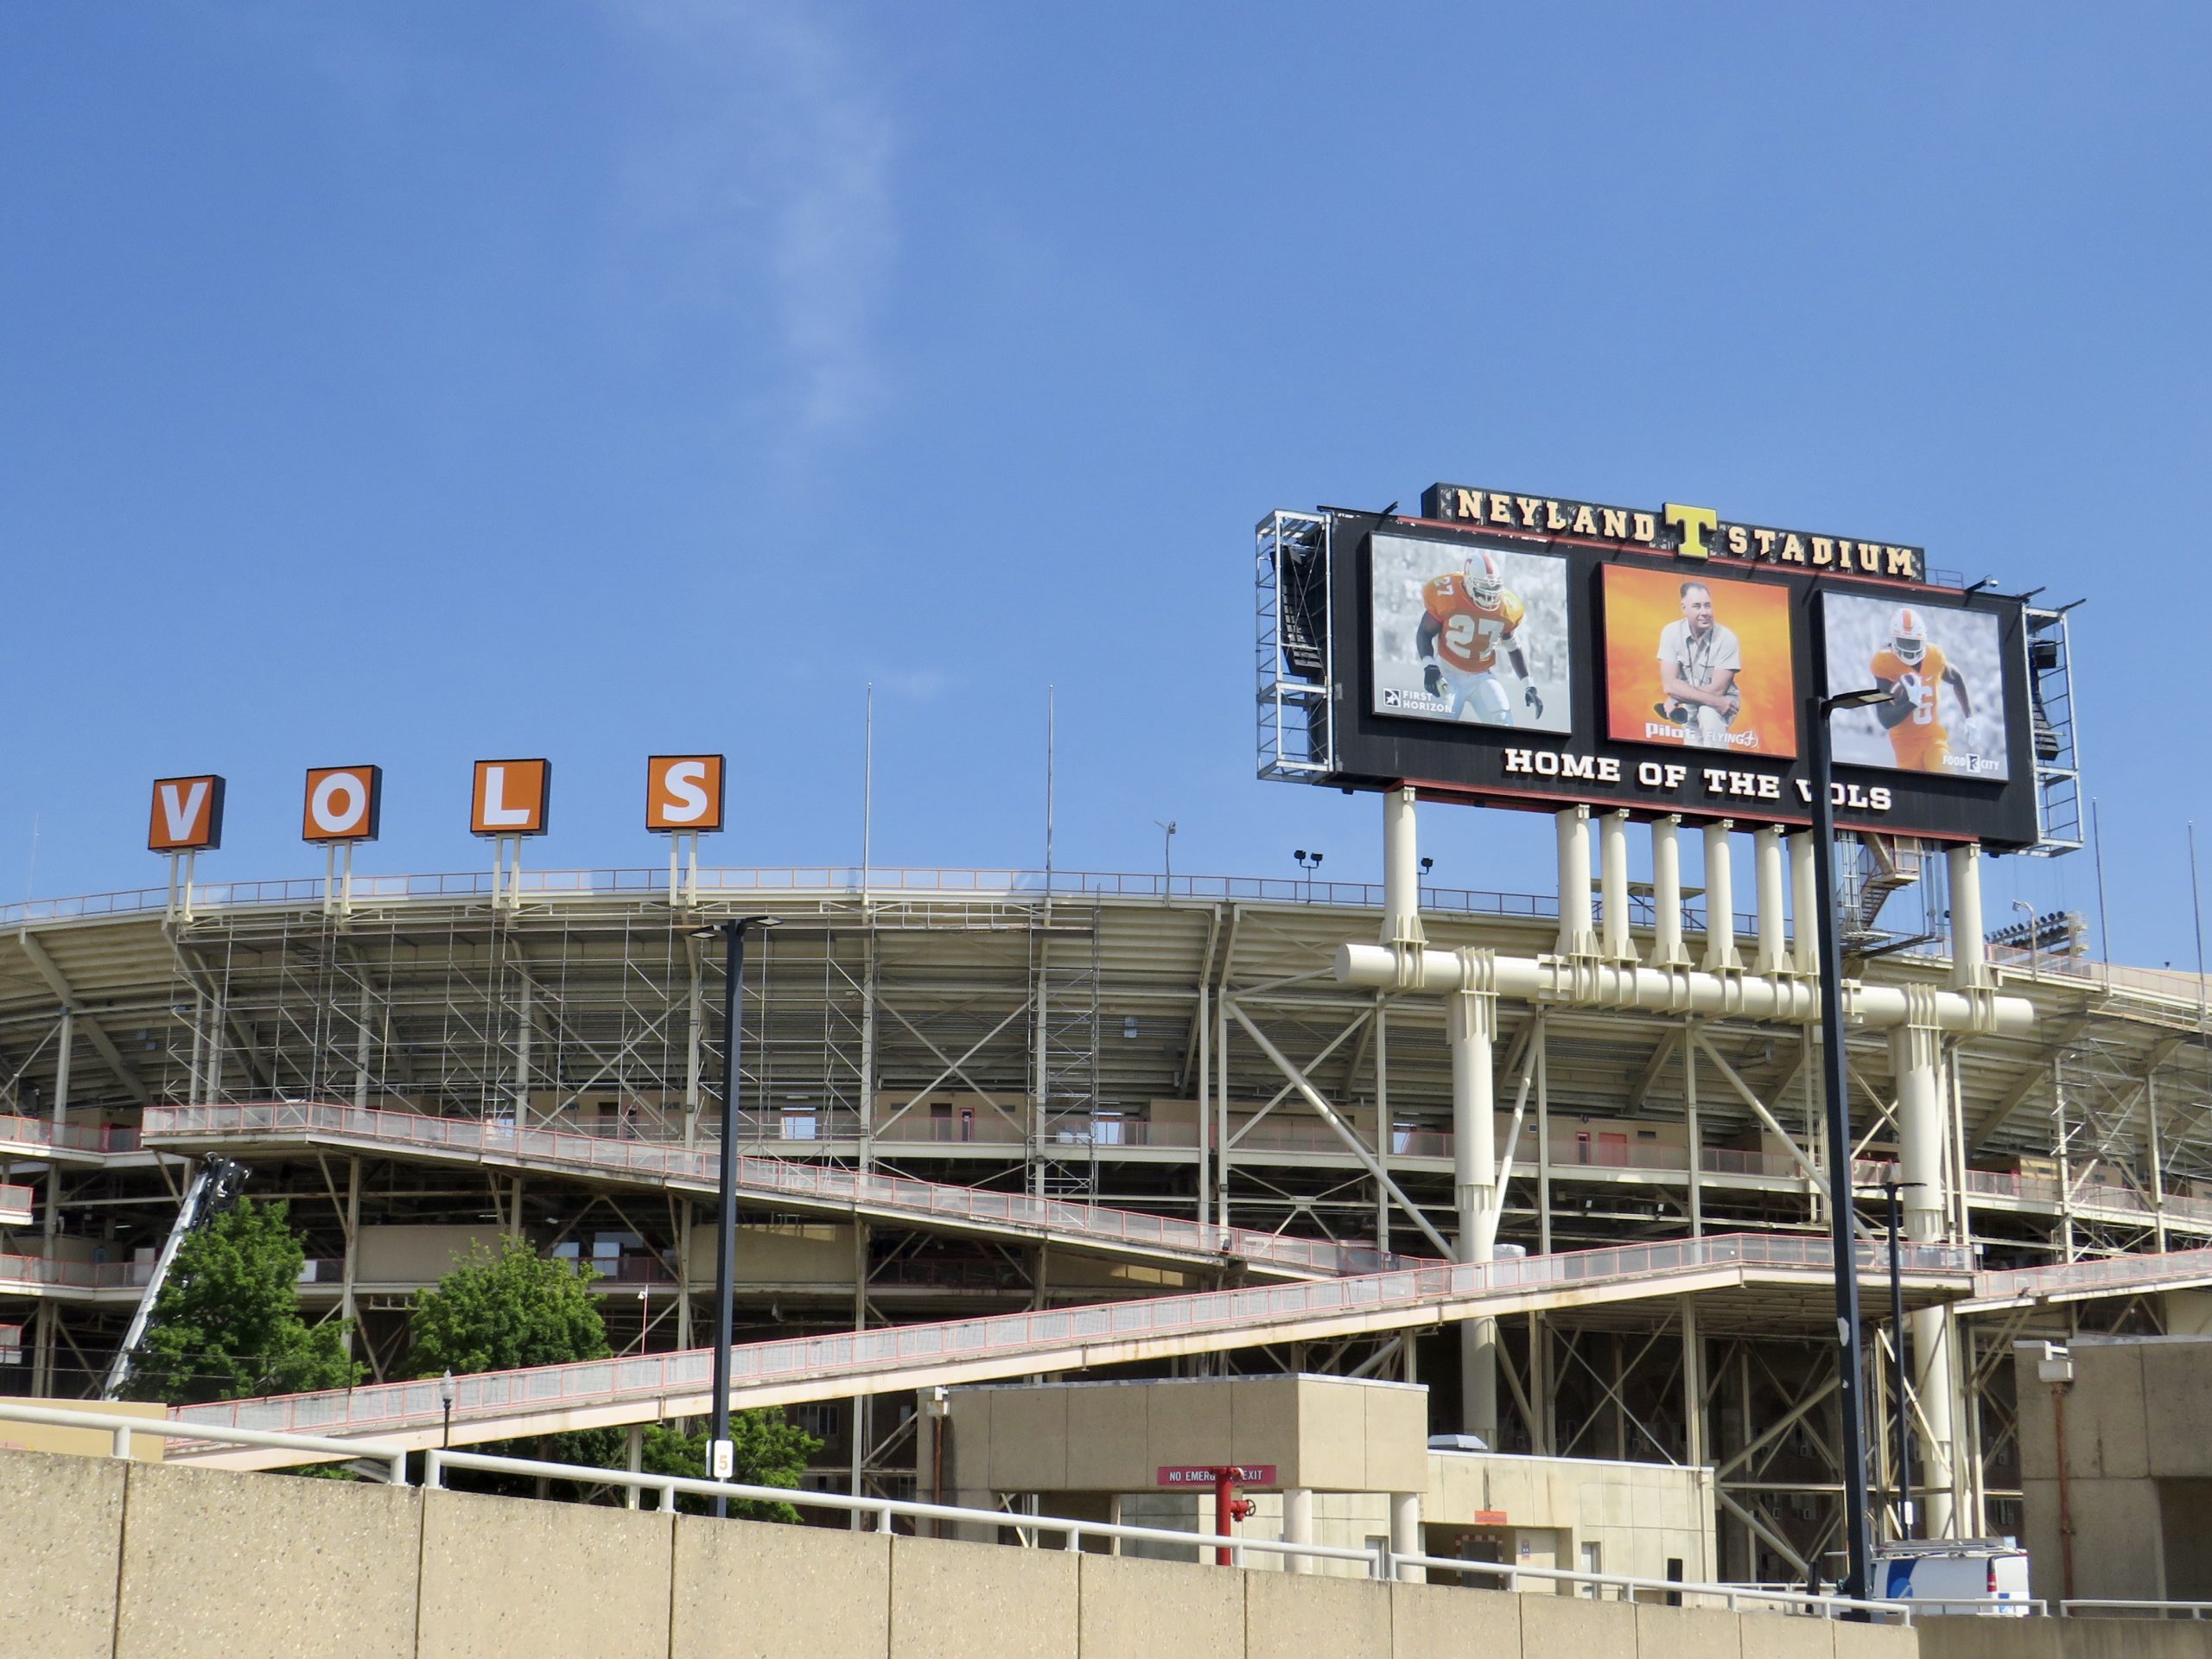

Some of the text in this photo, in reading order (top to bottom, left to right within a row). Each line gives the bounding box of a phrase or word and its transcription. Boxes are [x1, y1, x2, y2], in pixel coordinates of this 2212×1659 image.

[1457, 489, 1913, 577] NEYLAND T STADIUM
[1445, 614, 1505, 660] 27
[1402, 690, 1433, 702] FIRST
[1402, 700, 1452, 714] HORIZON
[1942, 755, 1967, 767] FOOD
[1980, 759, 2000, 770] CITY
[1504, 748, 1621, 782] HOME
[1638, 762, 1687, 788] OF
[1703, 768, 1781, 799] THE
[718, 1454, 729, 1471] 5
[1169, 1470, 1263, 1482] NO EMERG EXIT
